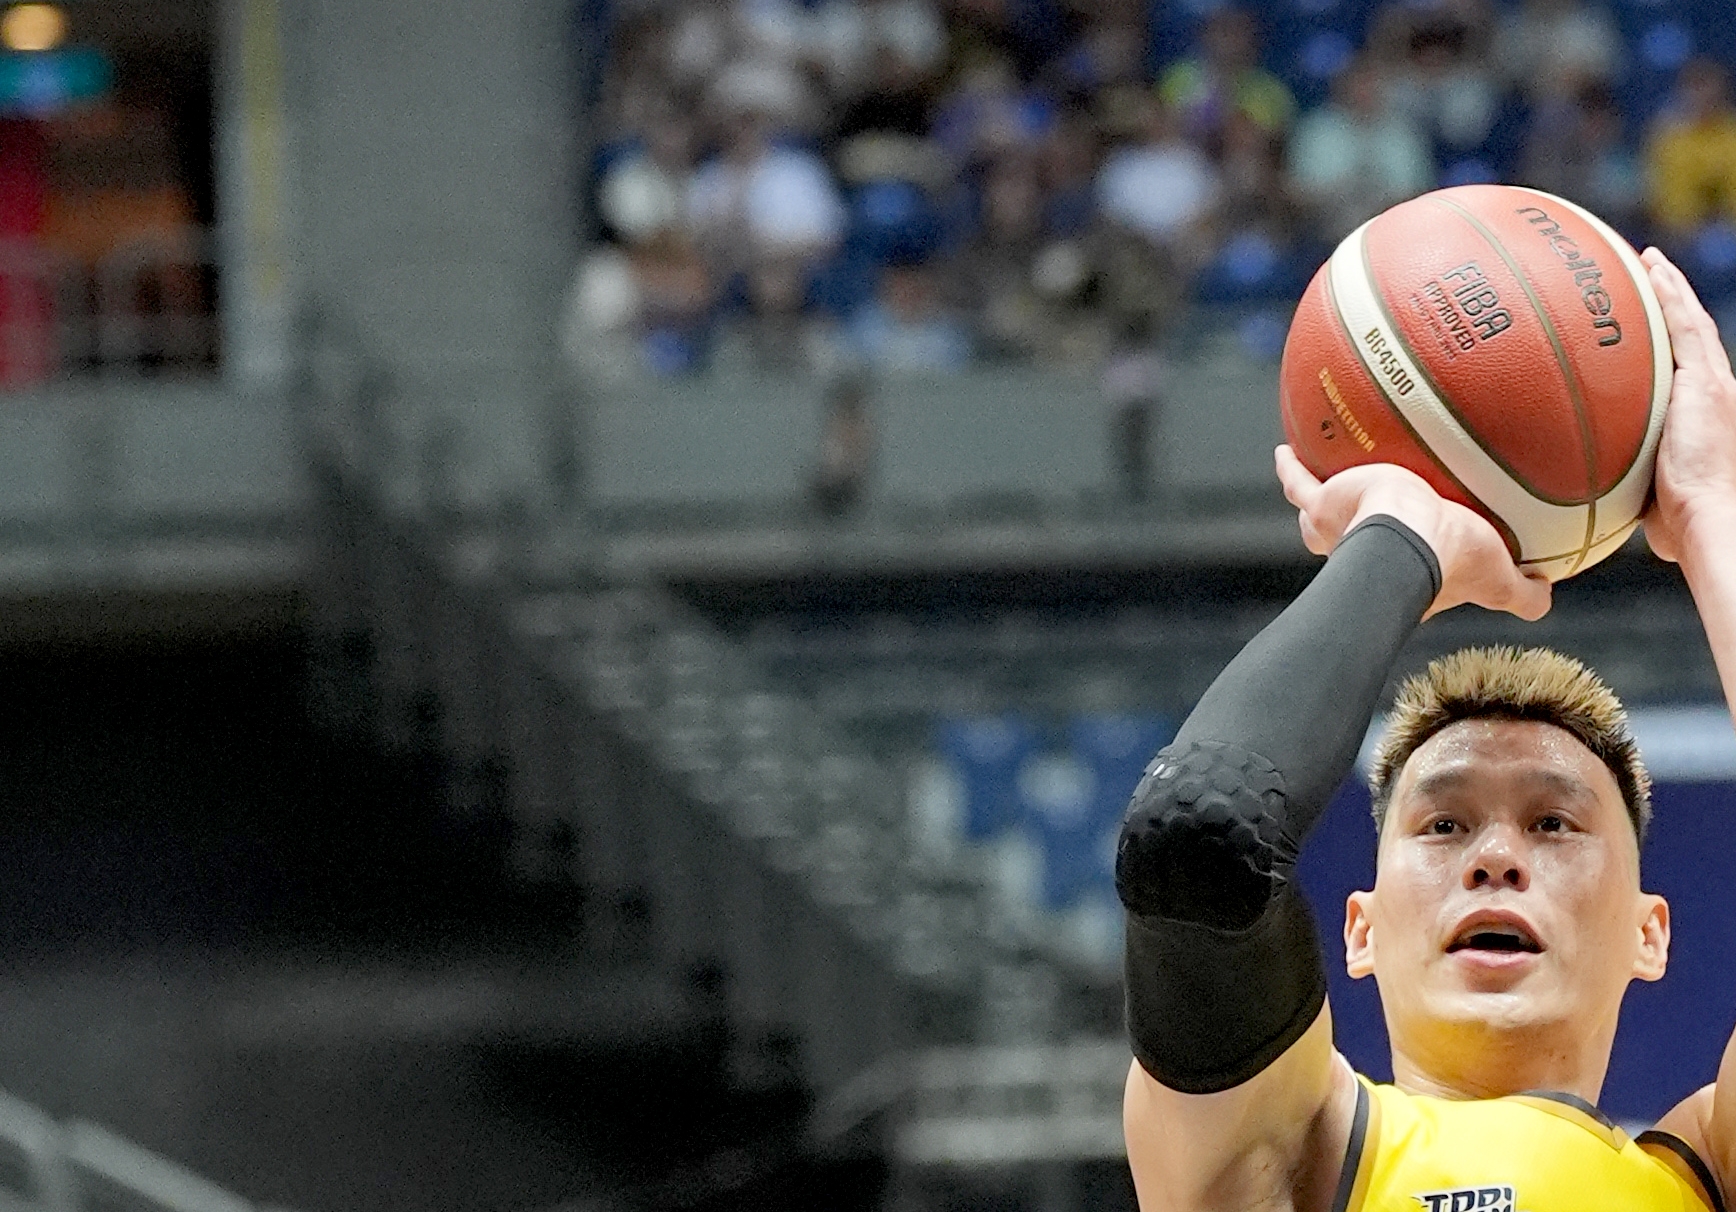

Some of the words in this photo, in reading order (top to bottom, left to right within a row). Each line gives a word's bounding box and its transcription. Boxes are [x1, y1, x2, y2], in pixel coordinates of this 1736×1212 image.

[1442, 260, 1514, 341] FIBA
[1515, 204, 1623, 348] molten
[1422, 280, 1477, 352] APPROVED
[1363, 326, 1415, 397] BG4500
